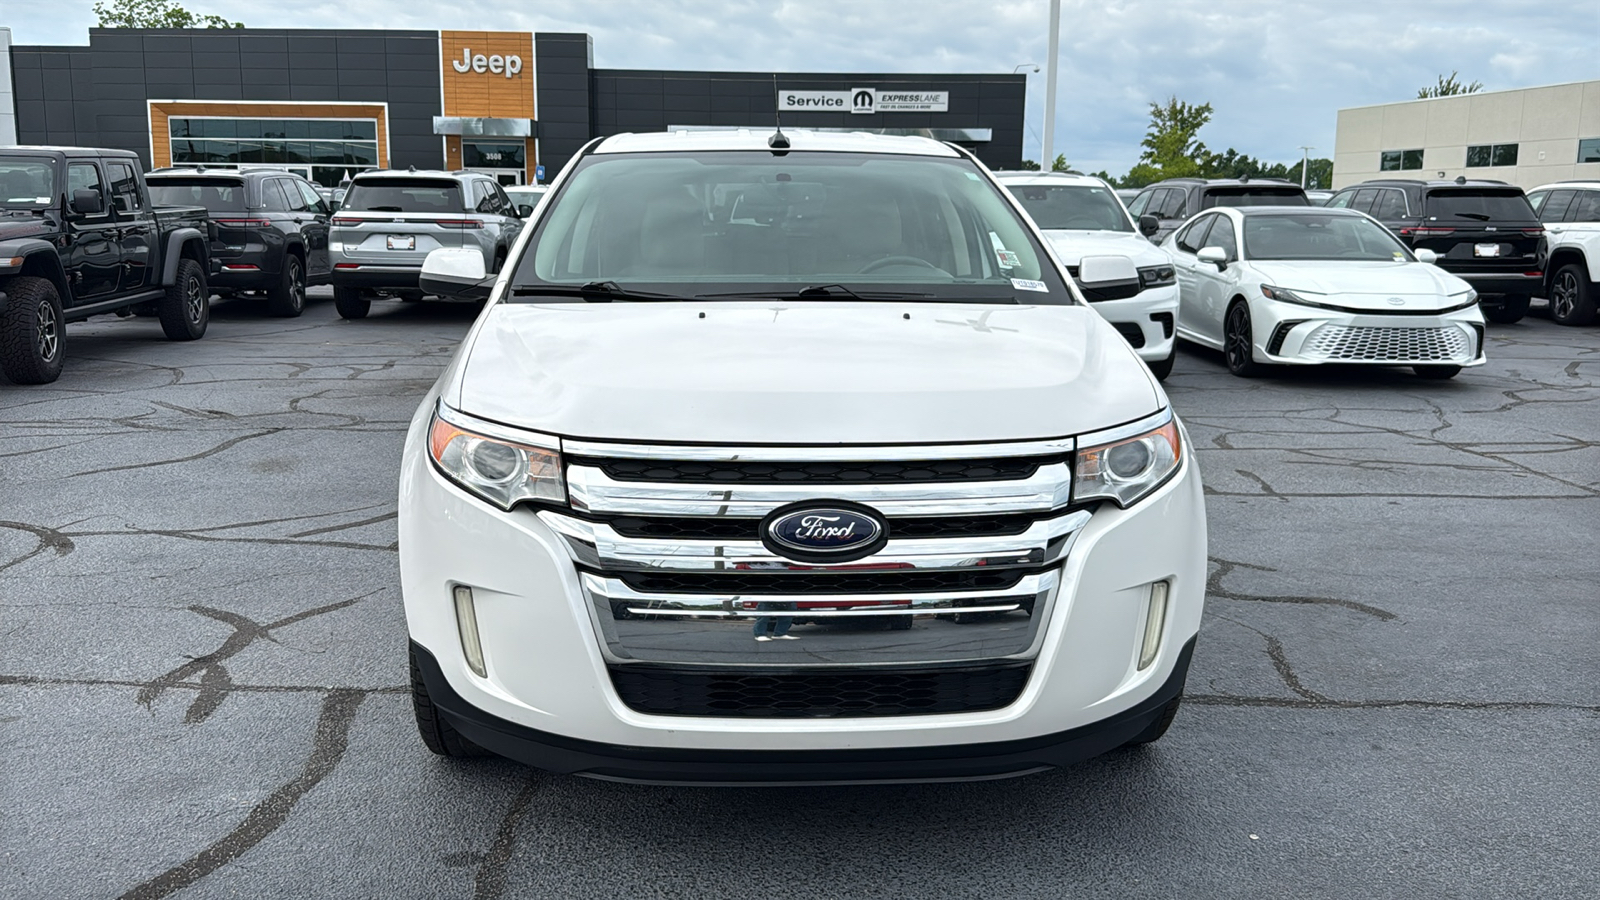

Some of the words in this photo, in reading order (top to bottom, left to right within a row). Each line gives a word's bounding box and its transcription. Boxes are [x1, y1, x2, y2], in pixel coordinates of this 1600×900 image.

[452, 47, 523, 79] Jeep
[786, 95, 844, 107] Service
[795, 515, 856, 540] Ford
